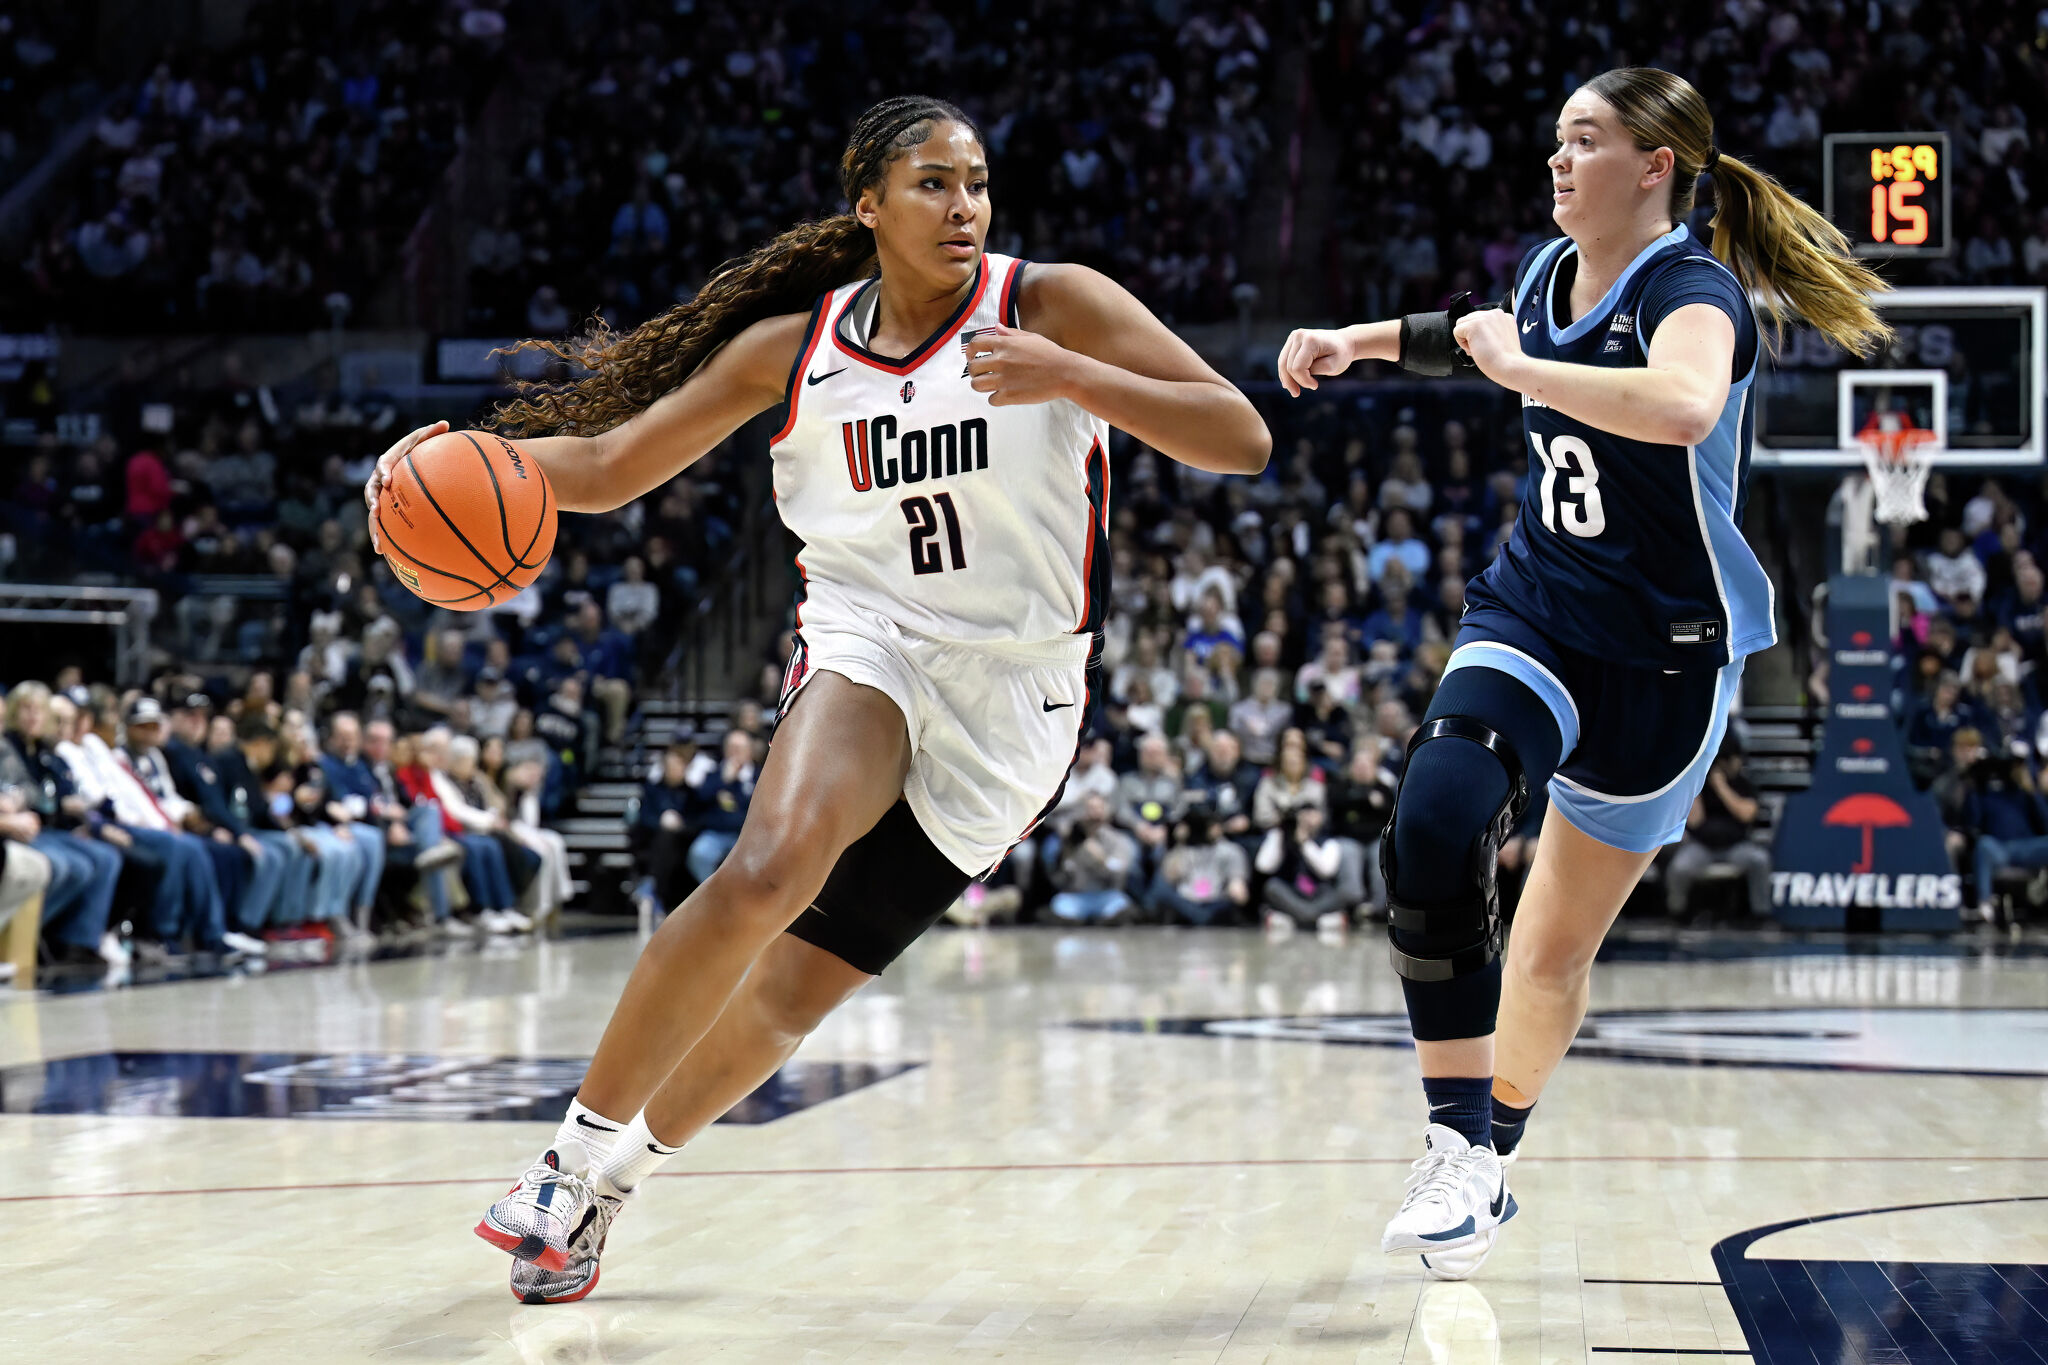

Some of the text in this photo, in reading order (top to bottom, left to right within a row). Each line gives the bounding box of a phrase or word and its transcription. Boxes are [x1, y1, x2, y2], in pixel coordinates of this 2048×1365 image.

[1871, 145, 1938, 181] 1:59
[1872, 181, 1928, 245] 15
[1610, 323, 1634, 333] ANGE
[1619, 314, 1635, 324] THE
[842, 414, 989, 493] UConn
[1529, 431, 1606, 538] 13
[900, 491, 967, 576] 21
[1706, 627, 1715, 637] M
[1770, 872, 1961, 907] TRAVELERS
